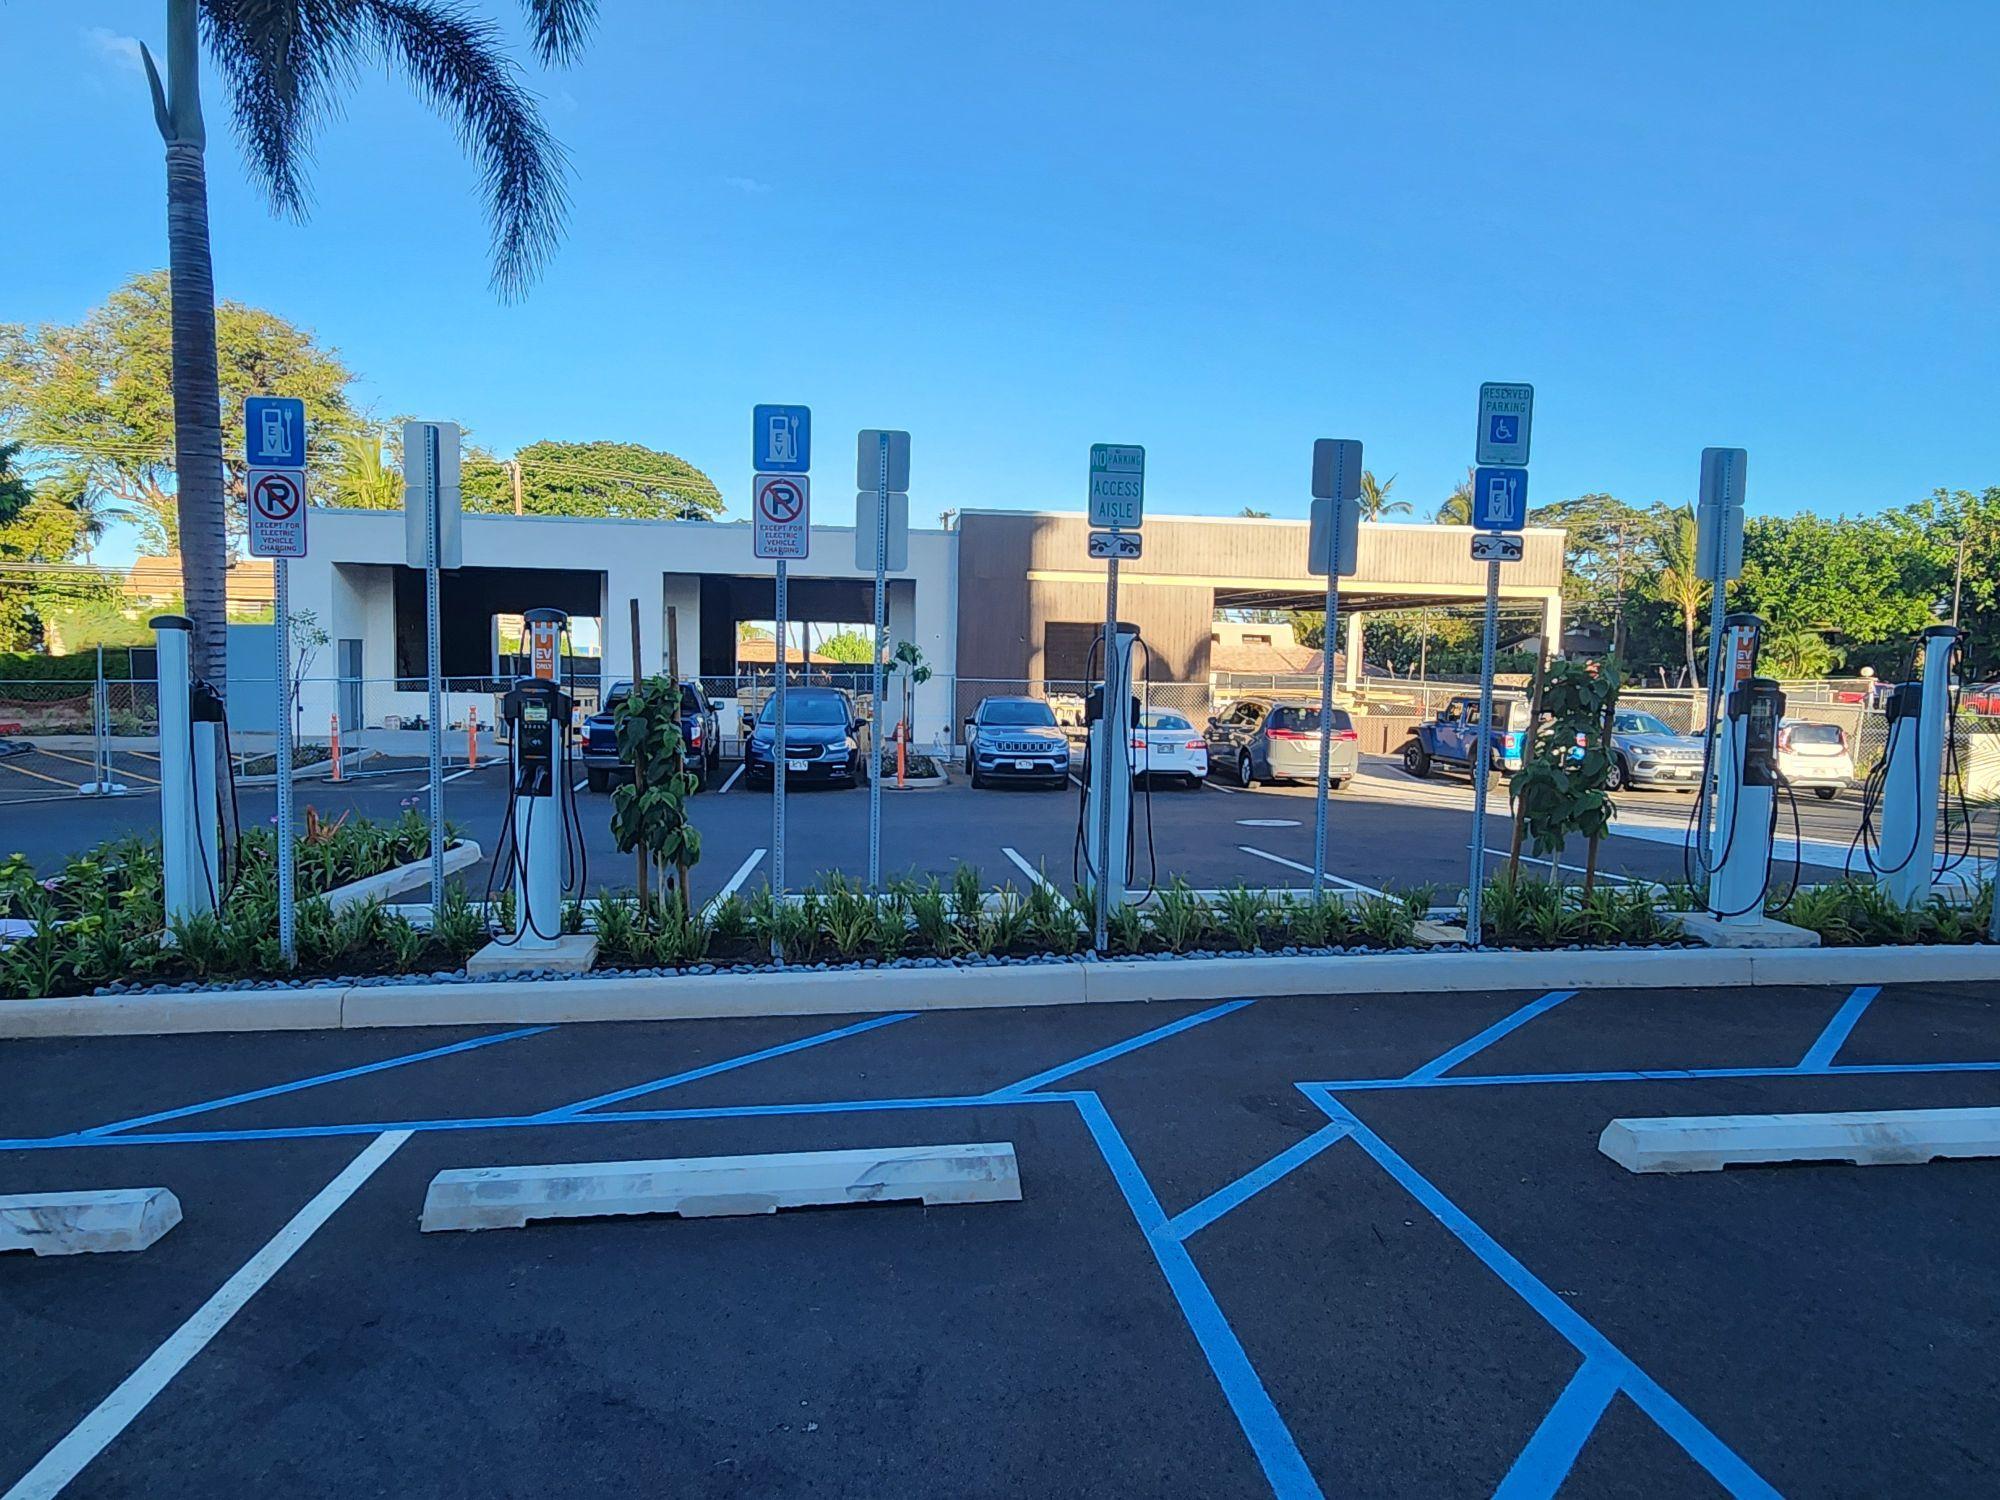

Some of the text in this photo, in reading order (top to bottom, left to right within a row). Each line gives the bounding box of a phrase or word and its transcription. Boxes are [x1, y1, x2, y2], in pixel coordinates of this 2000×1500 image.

[1484, 388, 1529, 400] RESERVED
[1486, 400, 1526, 413] PARKING
[268, 425, 276, 450] EV
[775, 433, 783, 456] EV
[1092, 451, 1141, 466] NO PARKING
[1094, 480, 1139, 497] ACCESS
[1098, 502, 1133, 518] AISLE
[1494, 493, 1501, 515] EV
[260, 529, 295, 537] ELECTRIC
[259, 544, 297, 552] CHARGING
[536, 648, 552, 659] EV
[1738, 651, 1751, 659] EV
[536, 662, 552, 670] ONLY
